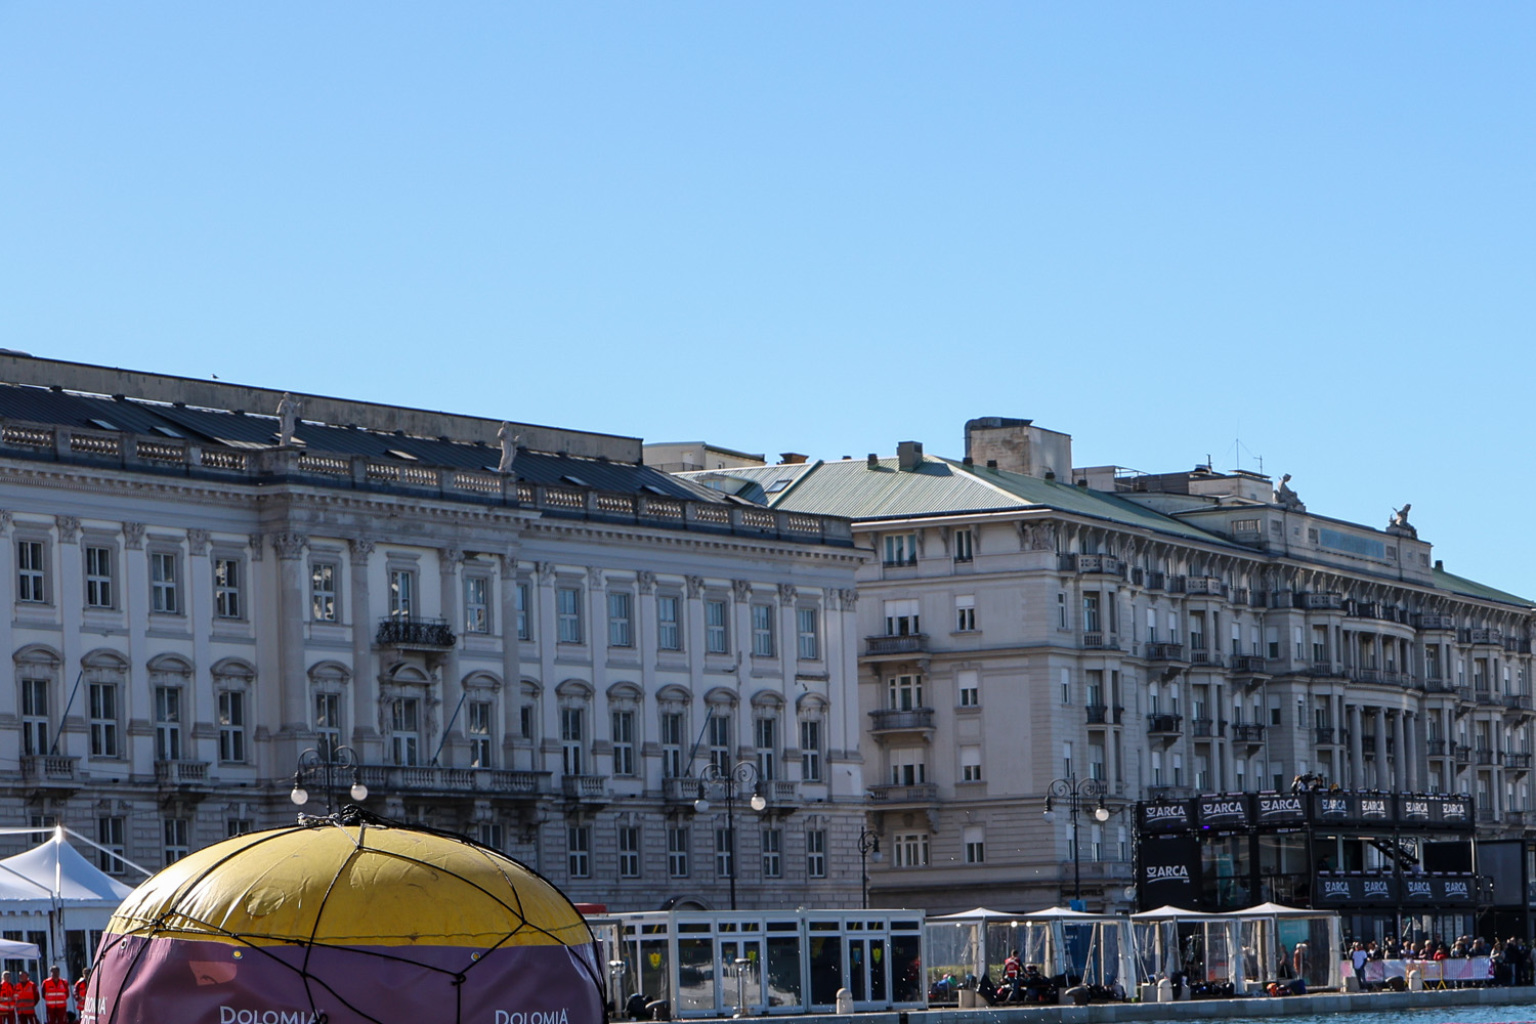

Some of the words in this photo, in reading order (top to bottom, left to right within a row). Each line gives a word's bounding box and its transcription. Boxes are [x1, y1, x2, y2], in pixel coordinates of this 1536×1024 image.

[1214, 802, 1243, 814] ARCA
[1272, 799, 1301, 810] ARCA
[1157, 806, 1186, 816] ARCA
[1157, 865, 1188, 877] ARCA
